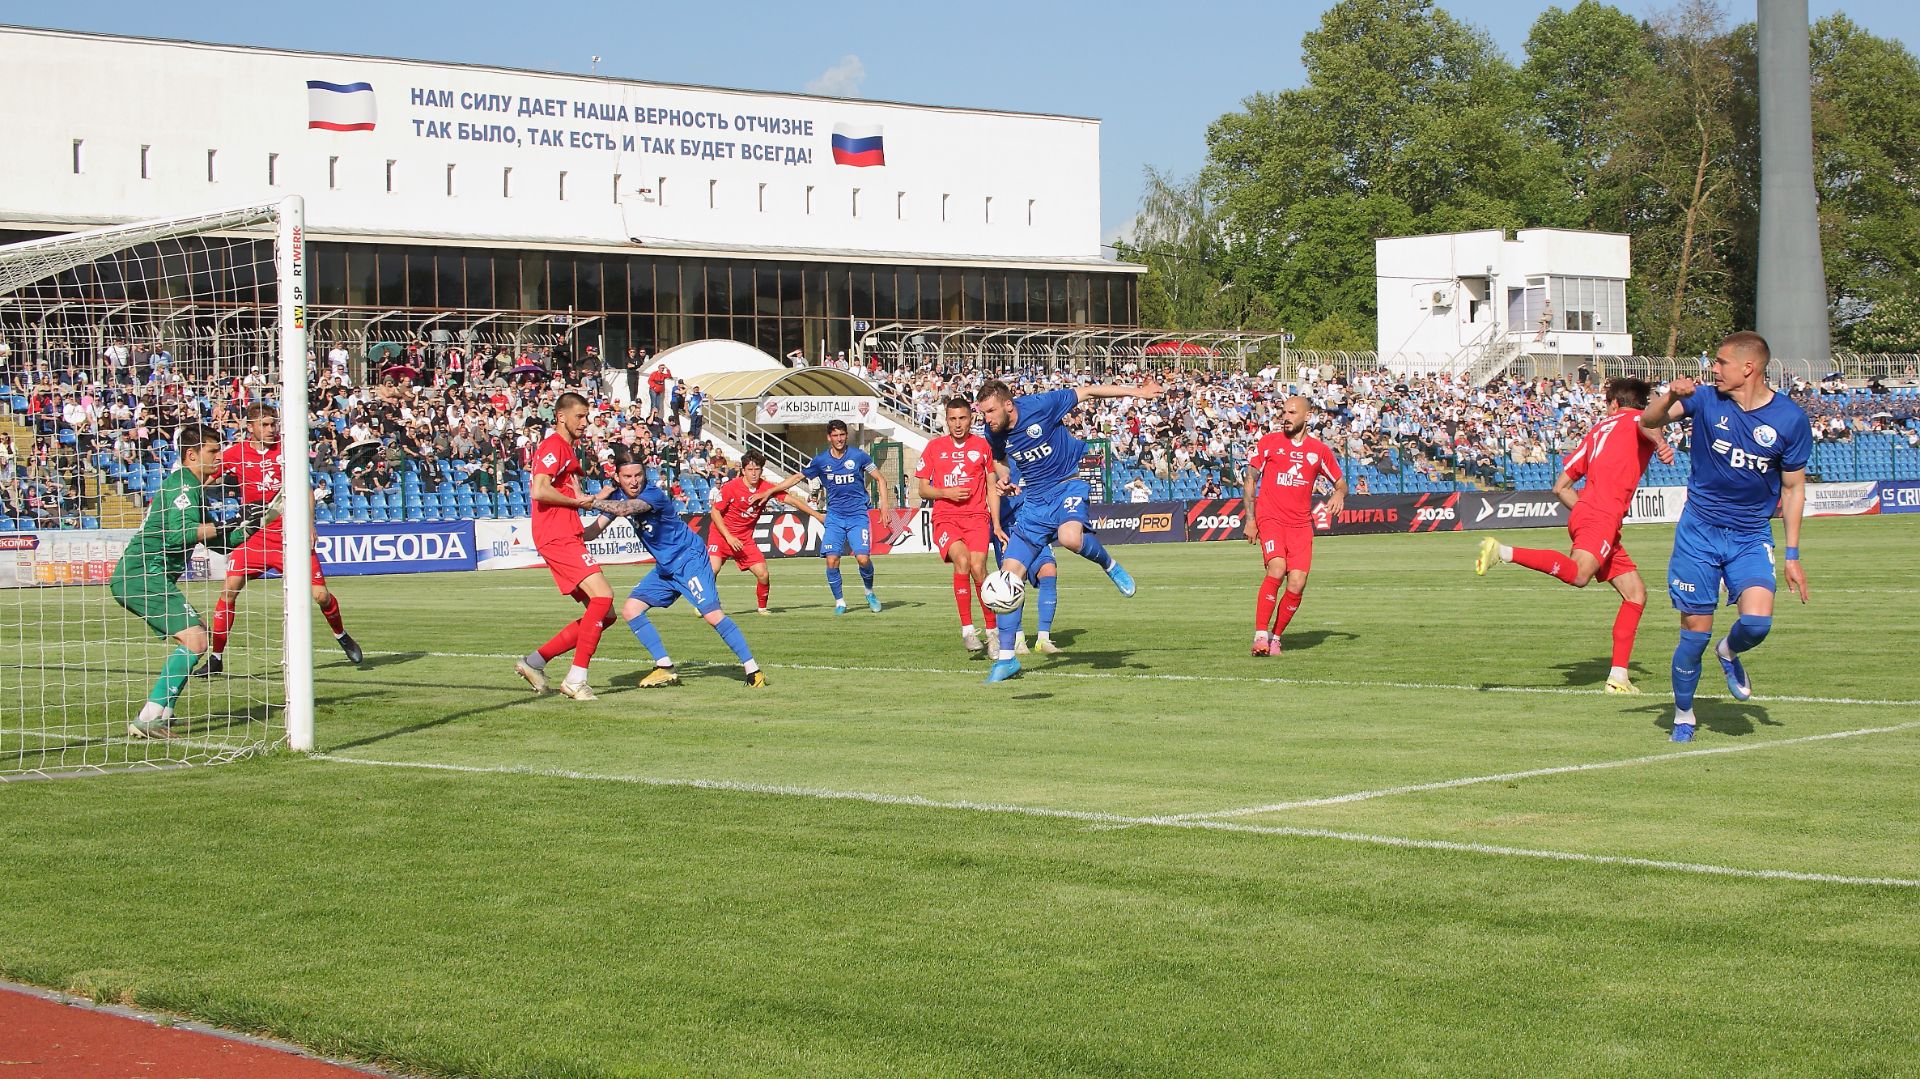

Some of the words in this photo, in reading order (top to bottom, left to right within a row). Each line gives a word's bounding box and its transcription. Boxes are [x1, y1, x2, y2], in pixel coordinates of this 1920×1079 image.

[411, 88, 454, 108] НАМ
[460, 92, 512, 113] СИЛУ
[517, 97, 567, 118] ДАЕТ
[574, 101, 629, 123] НАША
[634, 106, 729, 130] ВЕРНОСТЬ
[734, 115, 814, 137] ОТЧИЗНЕ
[412, 119, 452, 139] ТАК
[458, 122, 522, 148] БЫЛО,
[527, 128, 564, 147] ТАК
[570, 131, 617, 151] ЕСТЬ
[622, 135, 635, 152] И
[640, 136, 676, 155] ТАК
[680, 139, 735, 161] БУДЕТ
[741, 143, 813, 166] ВСЕГДА!
[1023, 442, 1053, 463] ВТБ
[1290, 451, 1304, 459] CS
[1730, 448, 1771, 474] ВТБ
[835, 474, 854, 484] ВТБ
[1277, 472, 1293, 487] БЦЗ
[1882, 488, 1895, 500] CS
[1897, 488, 1920, 506] CRI
[1497, 502, 1560, 518] DEMIX
[1636, 488, 1665, 517] finch
[1337, 509, 1385, 524] ЛИГА
[1387, 509, 1398, 522] Б
[1417, 507, 1455, 520] 2026
[1143, 517, 1169, 529] PRO
[1197, 515, 1240, 529] 2026
[862, 529, 869, 540] 6
[939, 531, 949, 547] 22
[315, 533, 468, 563] RIMSODA
[492, 541, 510, 557] БЦЗ
[708, 545, 718, 553] 70
[1265, 540, 1274, 553] 10
[1679, 582, 1695, 592] ВТБ
